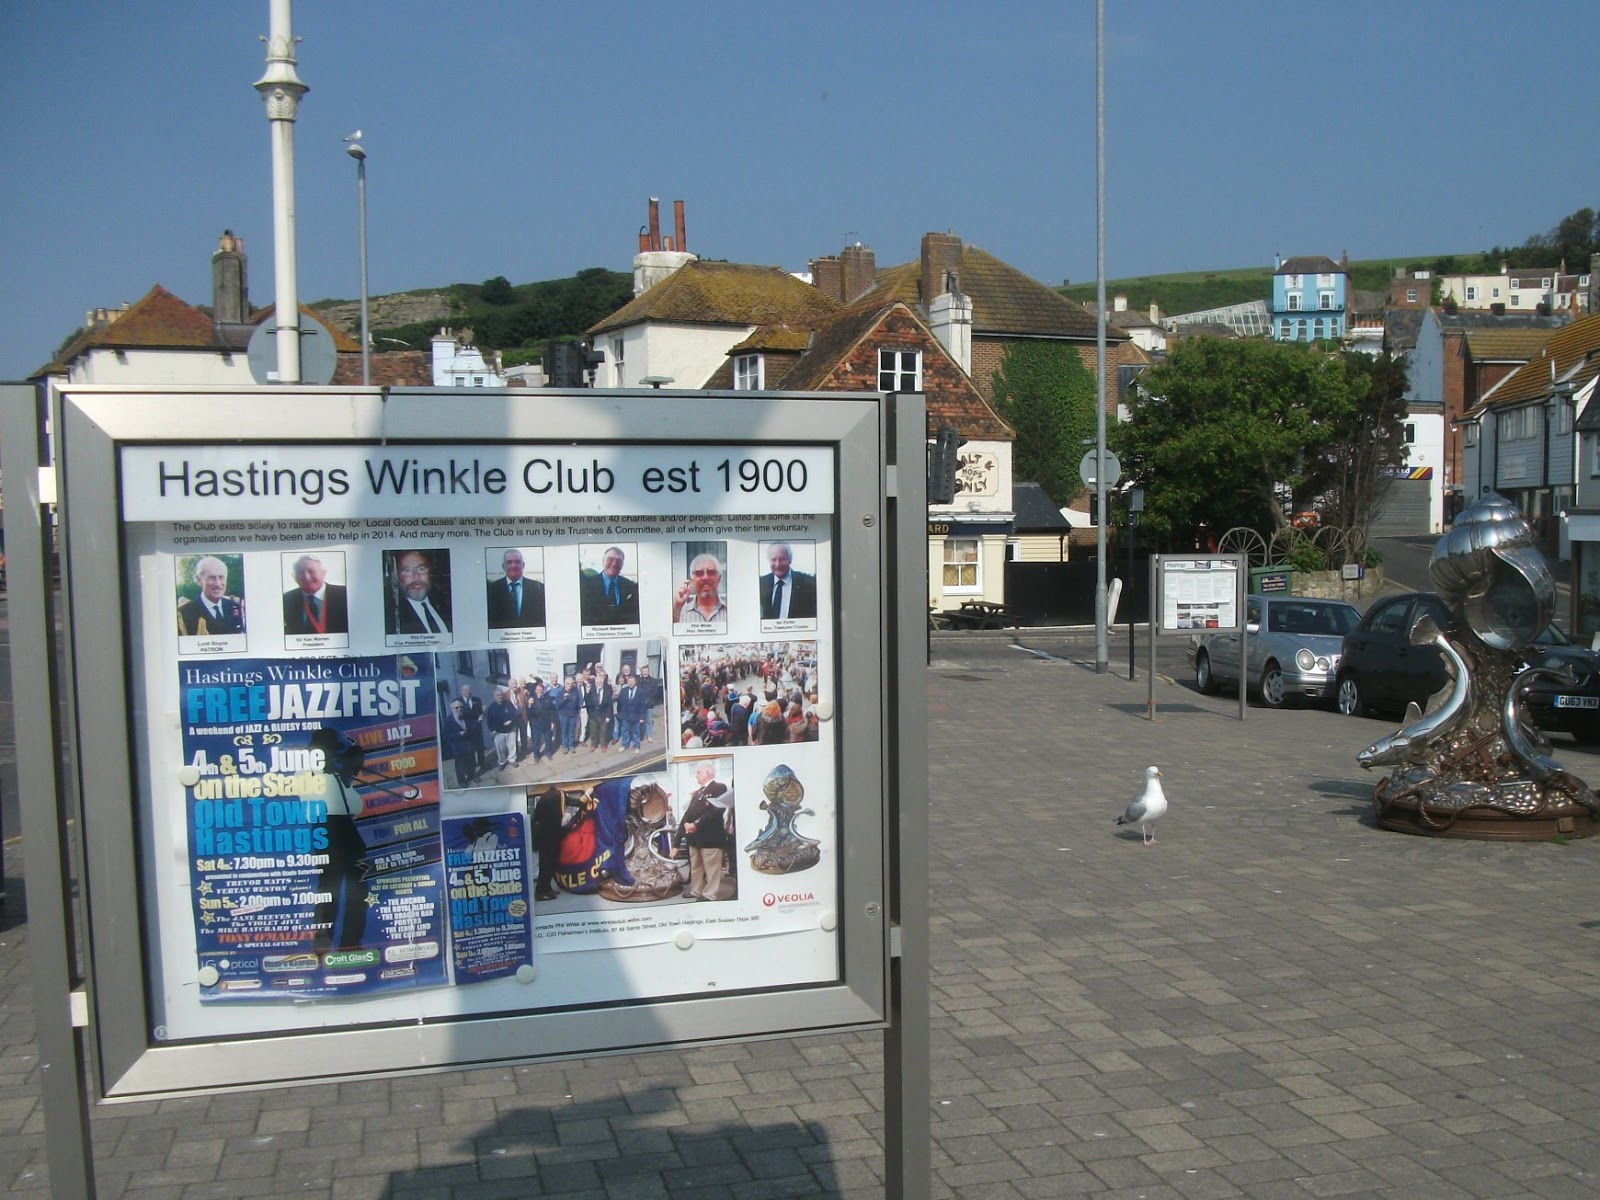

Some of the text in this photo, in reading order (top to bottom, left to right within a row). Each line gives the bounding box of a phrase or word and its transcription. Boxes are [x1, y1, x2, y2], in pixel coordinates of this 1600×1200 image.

[960, 453, 983, 465] ALT
[159, 458, 808, 505] Hastings Winkle Club est 1900
[962, 468, 983, 479] HOPS
[172, 522, 191, 532] The
[193, 521, 216, 531] Club
[218, 521, 246, 531] exists
[247, 520, 275, 532] solely
[277, 520, 287, 530] to
[289, 520, 312, 530] raise
[314, 521, 345, 532] money
[349, 518, 361, 528] for
[393, 517, 419, 527] Good
[459, 516, 476, 526] and
[478, 516, 494, 525] this
[496, 517, 516, 527] year
[518, 515, 533, 524] will
[534, 515, 560, 524] assist
[587, 514, 606, 523] than
[608, 514, 620, 523] 40
[621, 514, 657, 523] charities
[659, 513, 688, 523] and/or
[689, 513, 725, 524] projects.
[928, 524, 950, 534] ARD
[173, 523, 811, 546] organisations we have been able to help in 2014. And many more. The Club is run by its Trustees & Committee, all of whom give their time voluntary.
[186, 662, 382, 687] Hastings Winkle Club
[1559, 696, 1580, 706] GU63
[188, 721, 323, 736] A weekend of JAZZ & BLUESY SOUL
[358, 724, 413, 747] LIVE JAZZ
[191, 745, 327, 776] 4th & 5th June
[390, 756, 417, 772] FOOD
[193, 770, 328, 800] on the Stade
[194, 797, 329, 829] Old Town
[393, 818, 429, 837] FOR ALL
[196, 826, 330, 857] Hastings
[196, 854, 331, 872] Sat 7.30pm to 9.30pm
[226, 877, 292, 887] TREVOR WATTS
[490, 867, 522, 883] June
[252, 885, 288, 894] WESTON
[450, 887, 467, 900] on
[467, 884, 489, 899] the
[776, 892, 815, 903] VEOLIA
[199, 892, 334, 910] Sun 2.00pm to 7.00pm
[451, 897, 479, 915] Old
[247, 919, 279, 927] VIOLET
[280, 918, 302, 926] JIVE
[257, 912, 292, 921] REEVES
[292, 911, 316, 919] TRIO
[705, 917, 717, 925] East
[217, 926, 240, 934] MIKE
[240, 924, 290, 933] HATCHARD
[291, 922, 334, 932] QUARTET
[217, 933, 251, 944] TONY
[325, 954, 349, 966] Croft
